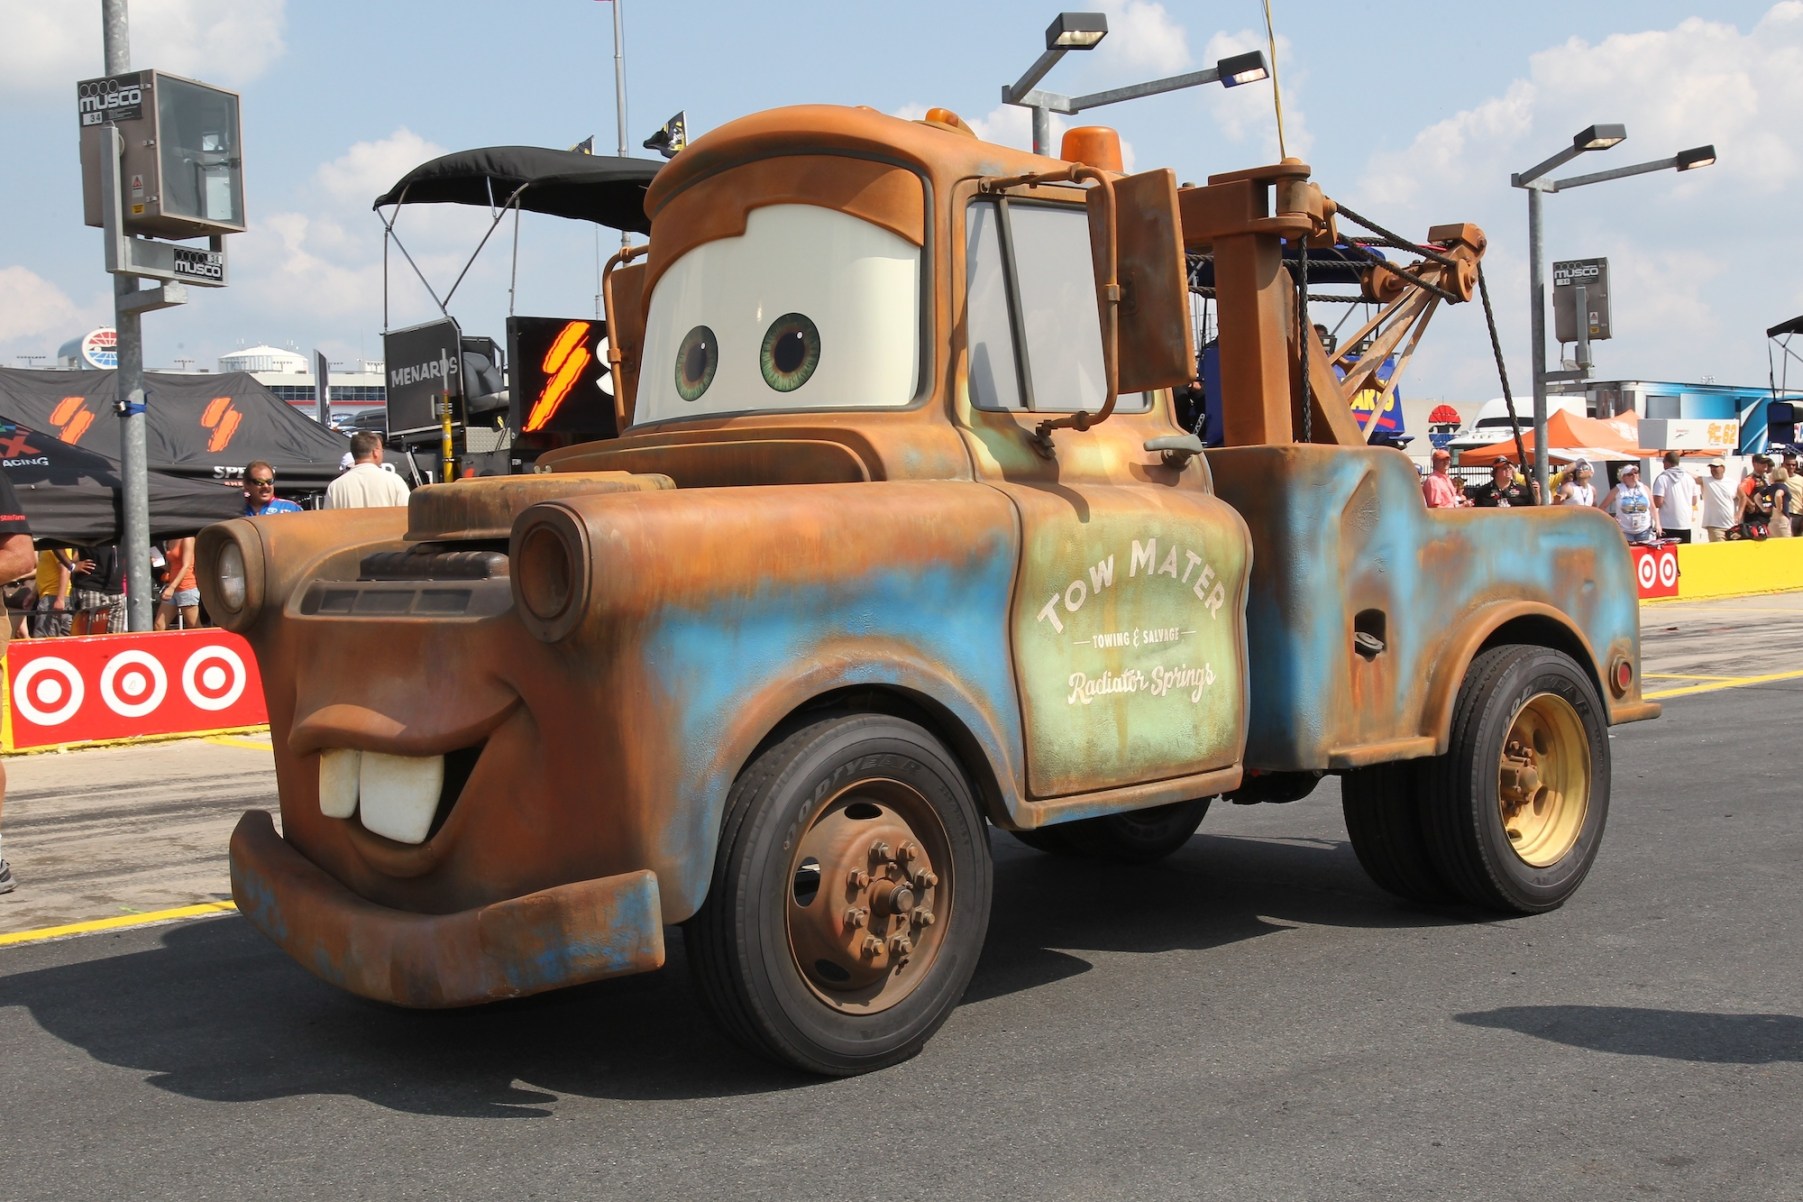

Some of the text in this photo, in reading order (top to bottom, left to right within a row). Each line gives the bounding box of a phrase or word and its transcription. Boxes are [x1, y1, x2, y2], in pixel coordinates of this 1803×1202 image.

[2, 457, 49, 468] ACING
[1037, 538, 1225, 634] TOW MATER
[1092, 631, 1130, 649] TOWING
[1143, 627, 1180, 644] SALVAGE
[1068, 662, 1216, 705] Radiator Springs
